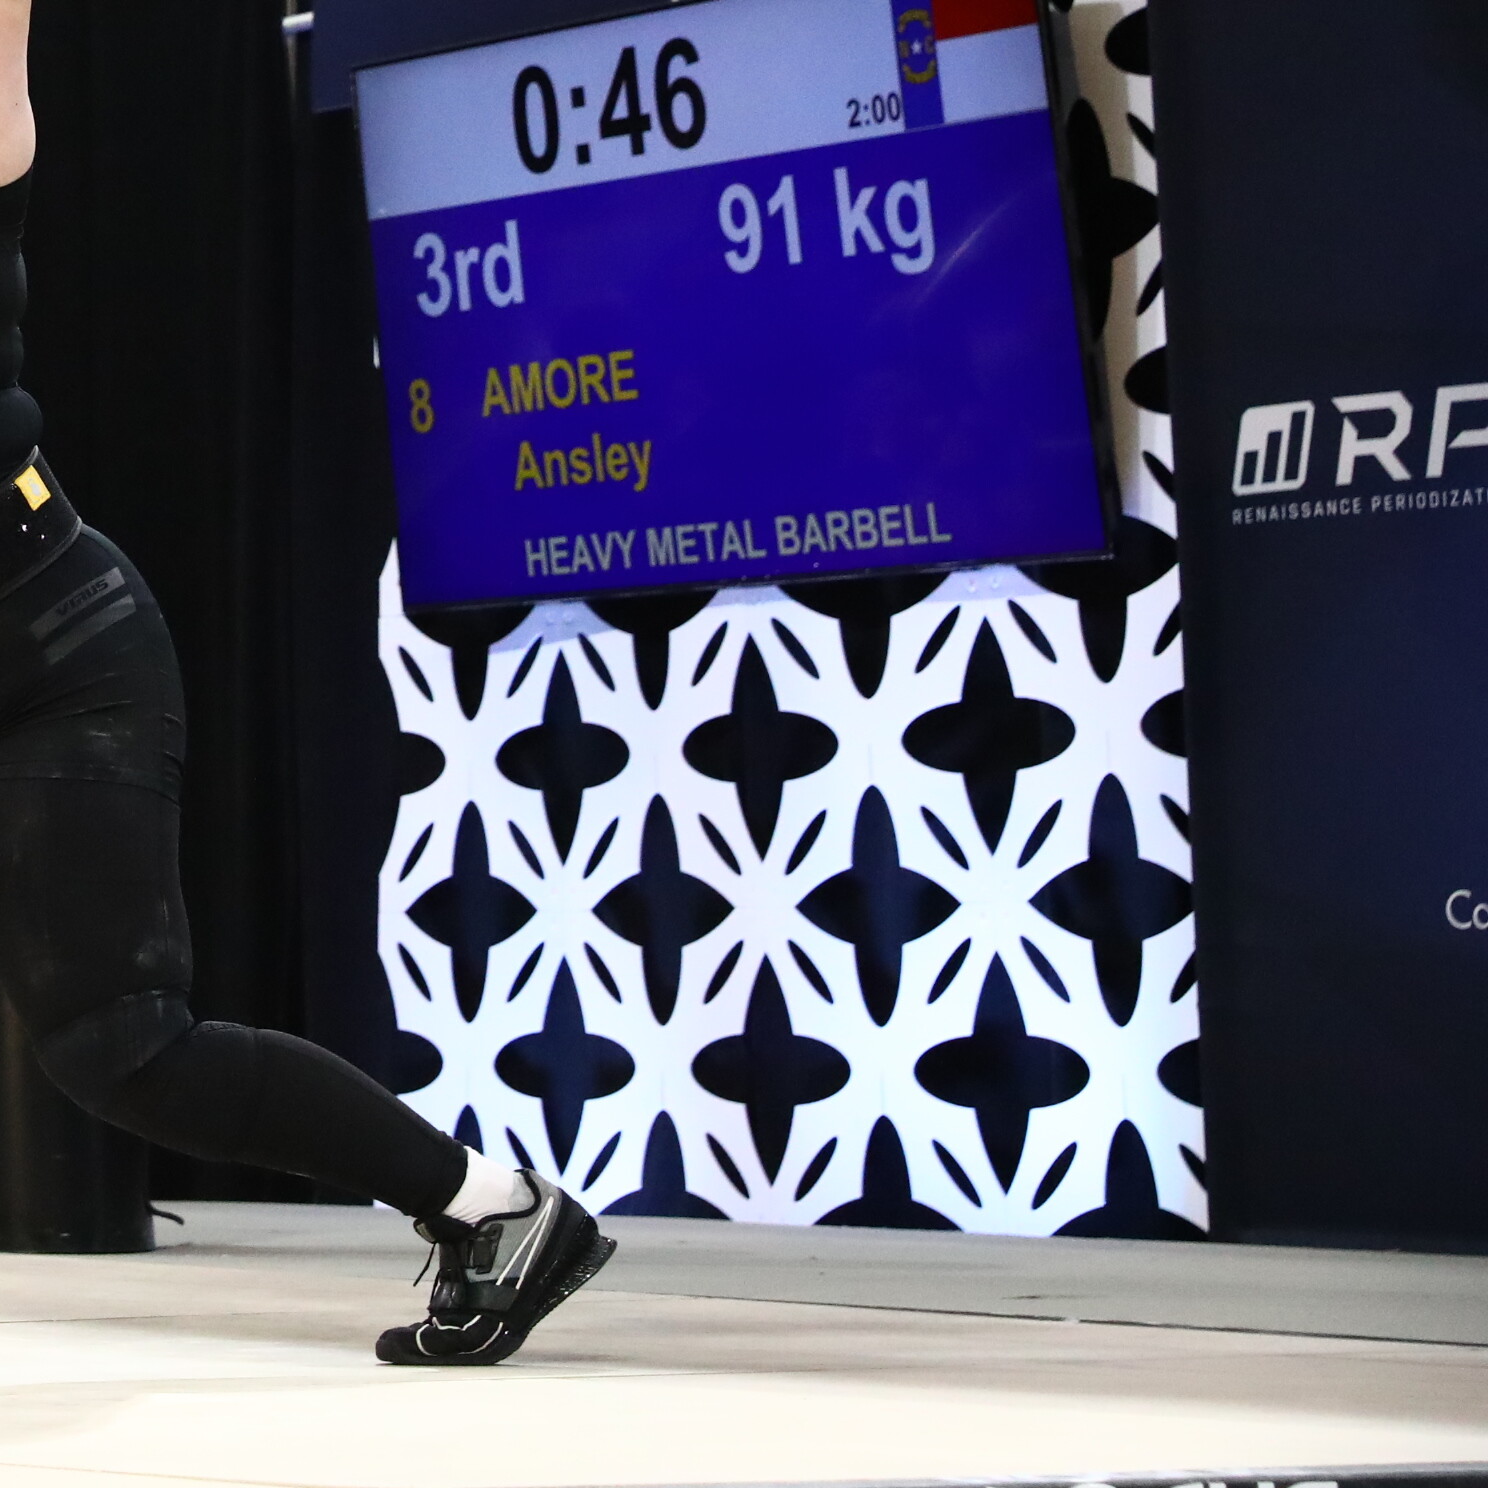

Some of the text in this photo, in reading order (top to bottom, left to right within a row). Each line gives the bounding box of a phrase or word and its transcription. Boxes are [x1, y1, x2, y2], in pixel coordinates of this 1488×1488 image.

[512, 37, 707, 174] 0:46
[847, 91, 902, 129] 2:00
[414, 166, 936, 318] 3rd 91 kg
[408, 349, 639, 433] 8 AMORE
[514, 432, 653, 492] Ansley
[524, 503, 952, 577] HEAVY METAL BARBELL
[1232, 486, 1488, 526] RENAISSANCE PERIODIZAT
